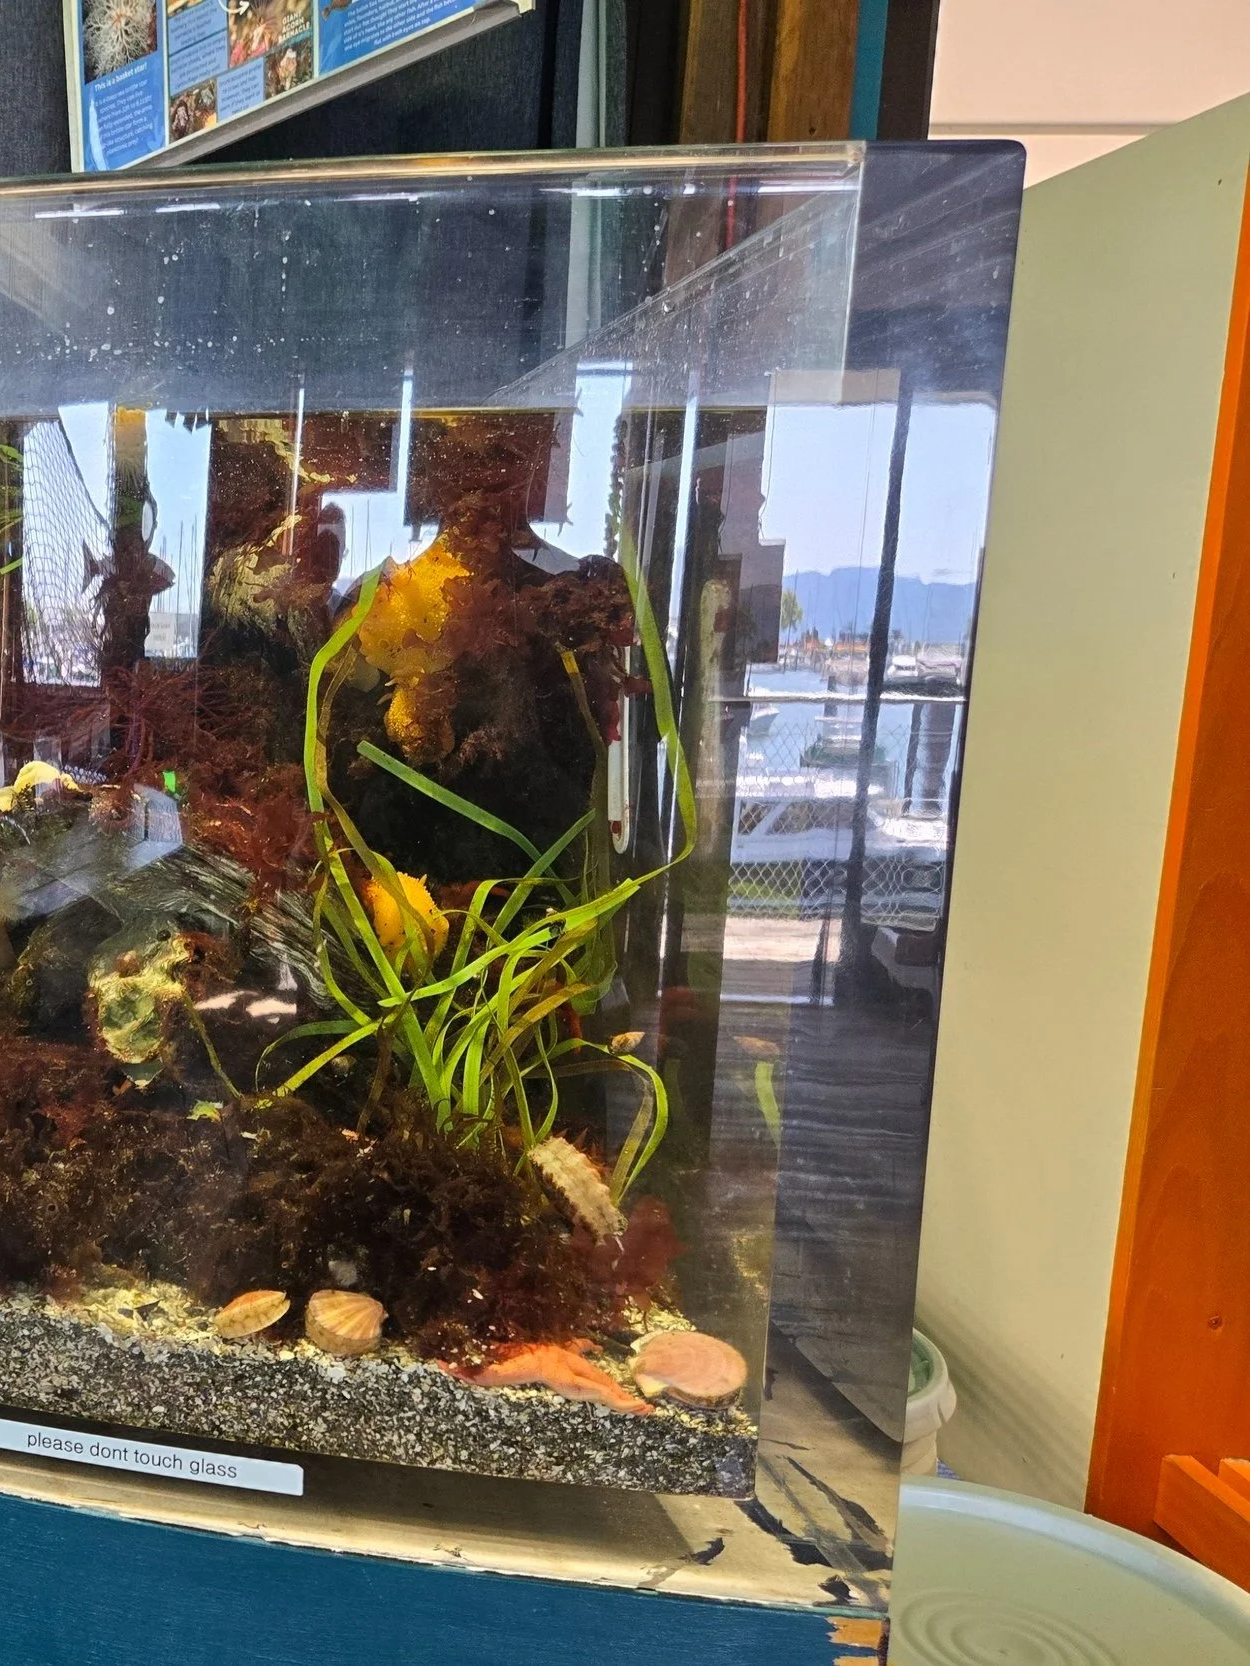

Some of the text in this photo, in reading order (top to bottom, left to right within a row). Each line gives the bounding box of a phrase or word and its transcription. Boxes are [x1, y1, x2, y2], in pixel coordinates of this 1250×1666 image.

[282, 17, 304, 34] ACORN
[95, 81, 106, 92] This
[116, 70, 134, 82] basket
[135, 63, 147, 74] star!
[27, 1431, 237, 1479] please dont touch glass
